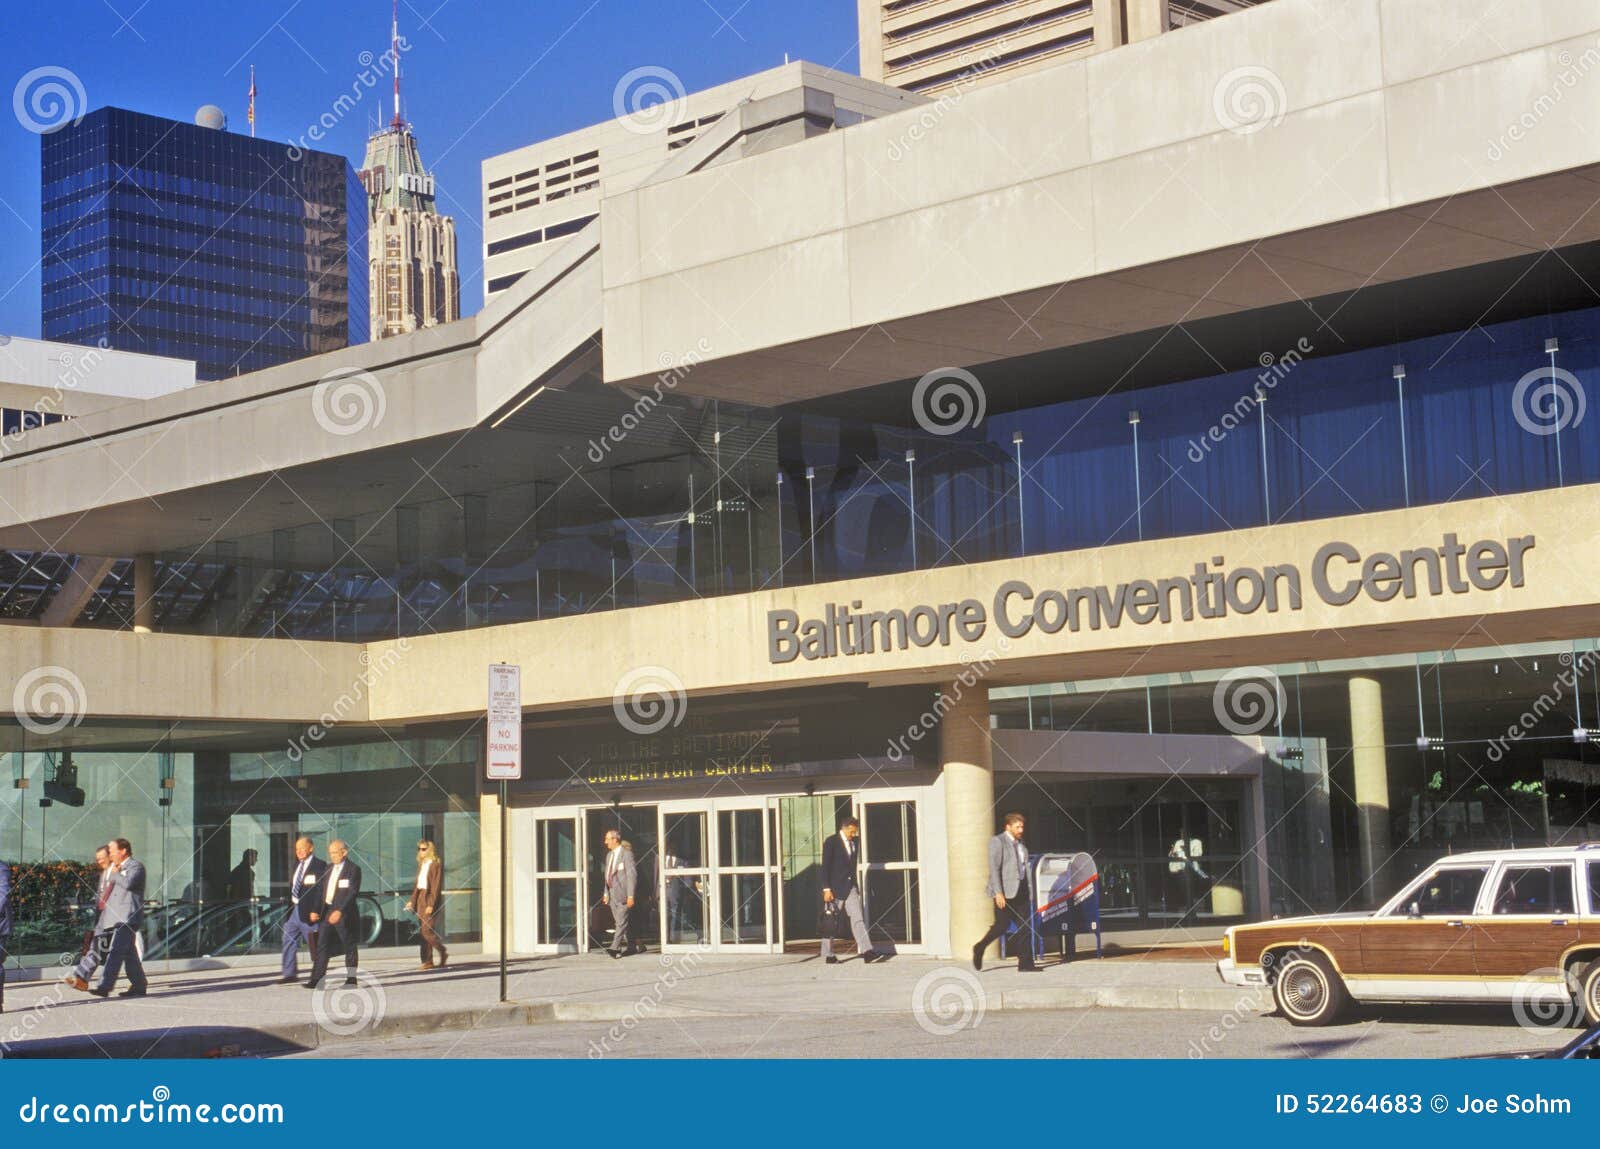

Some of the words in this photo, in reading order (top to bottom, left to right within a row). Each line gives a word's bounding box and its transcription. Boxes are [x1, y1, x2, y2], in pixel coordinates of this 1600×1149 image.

[767, 599, 987, 665] Baltimore
[993, 555, 1304, 639] Convention
[1311, 532, 1536, 606] Center
[498, 729, 511, 738] NO
[489, 743, 519, 752] PARKING
